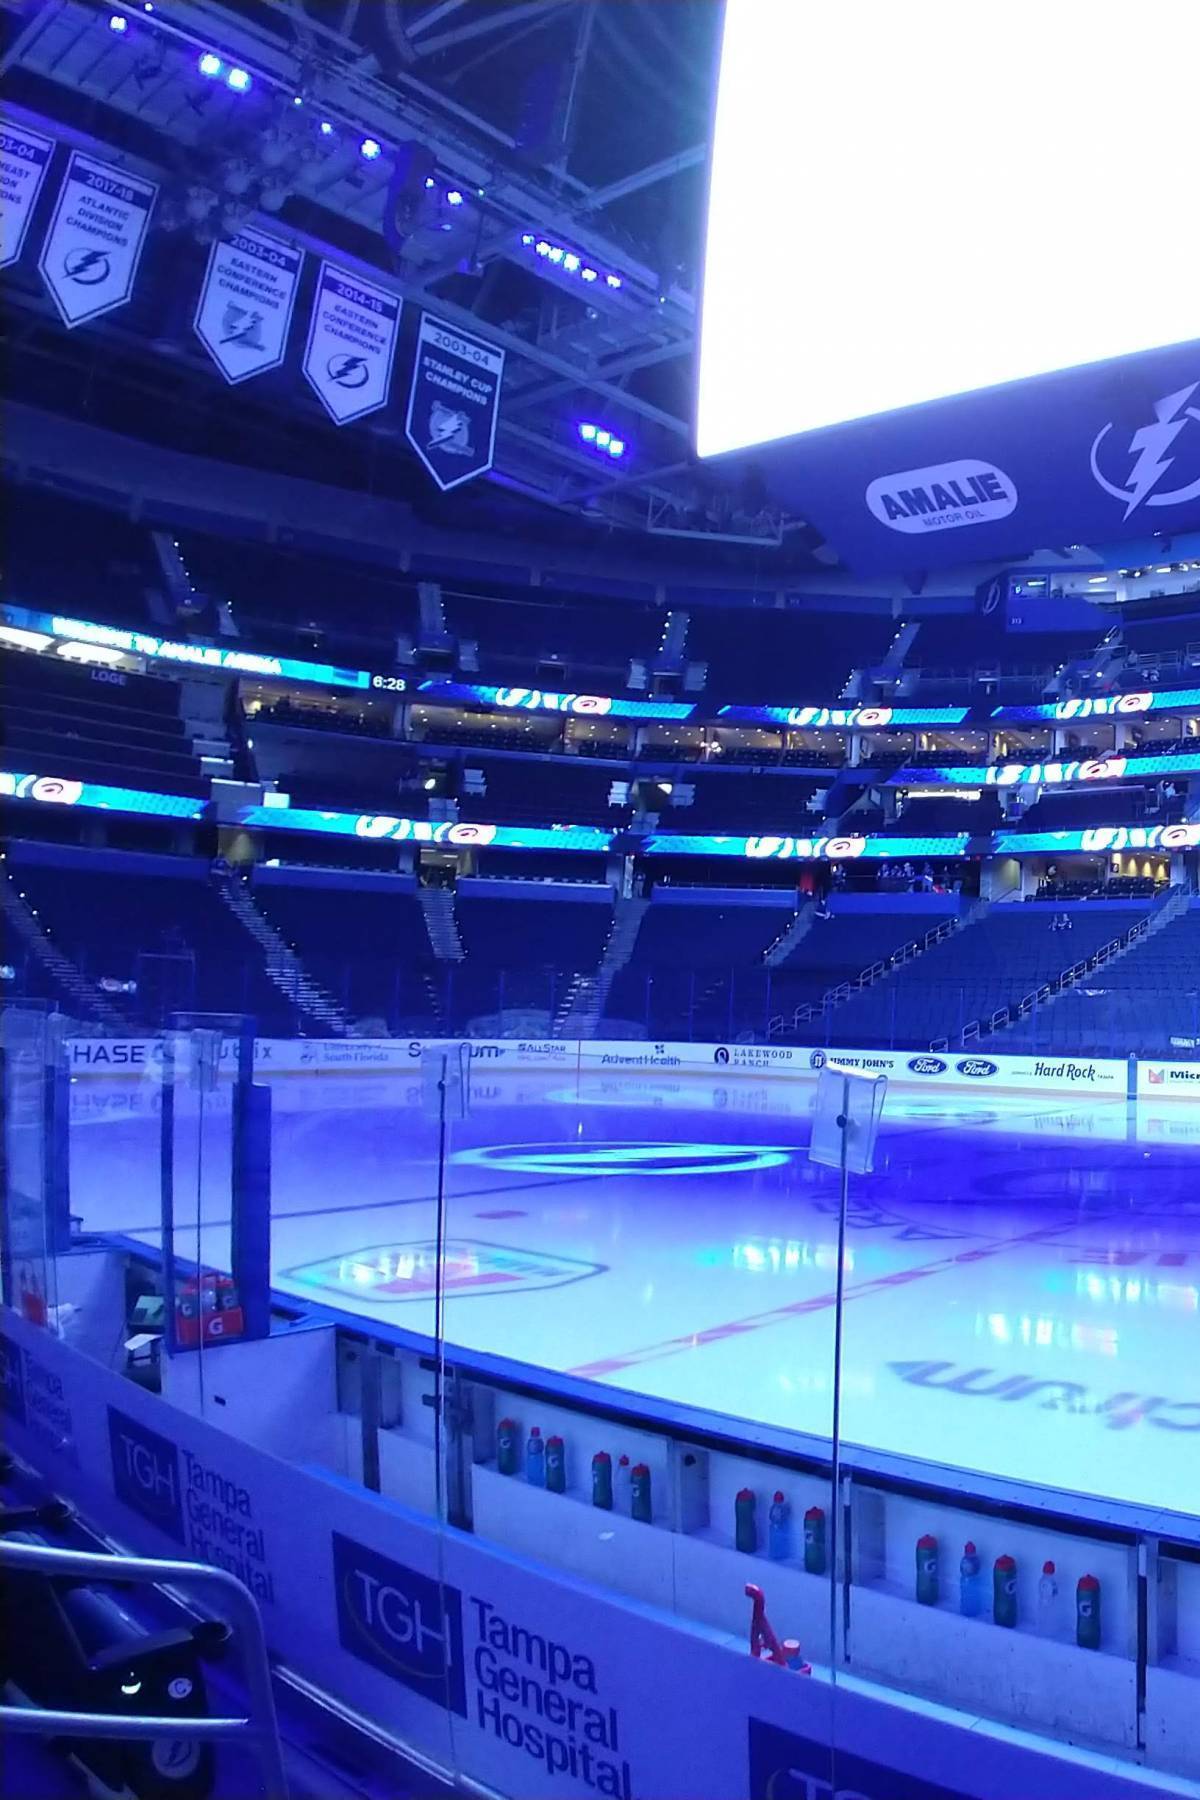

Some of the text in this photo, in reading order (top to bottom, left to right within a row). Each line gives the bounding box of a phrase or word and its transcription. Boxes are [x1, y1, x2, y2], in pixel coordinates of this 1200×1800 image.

[86, 173, 134, 201] 2017-18
[77, 207, 124, 232] DIVISION
[78, 195, 130, 221] ATLANTIC
[66, 216, 128, 247] CHAMPIONS
[217, 264, 287, 300] CONFERENCE
[231, 257, 278, 283] EASTERN
[218, 278, 280, 309] CHAMPIONS
[322, 310, 387, 345] CONFERENCE
[334, 304, 379, 330] EASTERN
[324, 324, 381, 355] CHAMPIONS
[423, 356, 493, 393] STANLEY CUP
[425, 371, 488, 406] CHAMPIONS
[880, 472, 1009, 521] AMALIE
[922, 510, 985, 527] MOTOR OIL
[91, 669, 128, 686] LOGE
[372, 675, 406, 691] 6:28
[73, 1044, 146, 1064] HASE
[734, 1048, 793, 1060] LAKEWOOD
[862, 1058, 895, 1069] JOHN'S
[913, 1058, 942, 1074] Ford
[963, 1060, 992, 1075] Ford
[1034, 1062, 1064, 1078] Hard
[1066, 1063, 1097, 1081] Rock
[119, 1433, 176, 1506] TGH
[182, 1448, 252, 1519] Tampa
[185, 1486, 266, 1563] General
[353, 1569, 454, 1668] TGH
[469, 1596, 598, 1695] Tampa
[474, 1647, 620, 1753] General
[476, 1691, 633, 1800] Hospital
